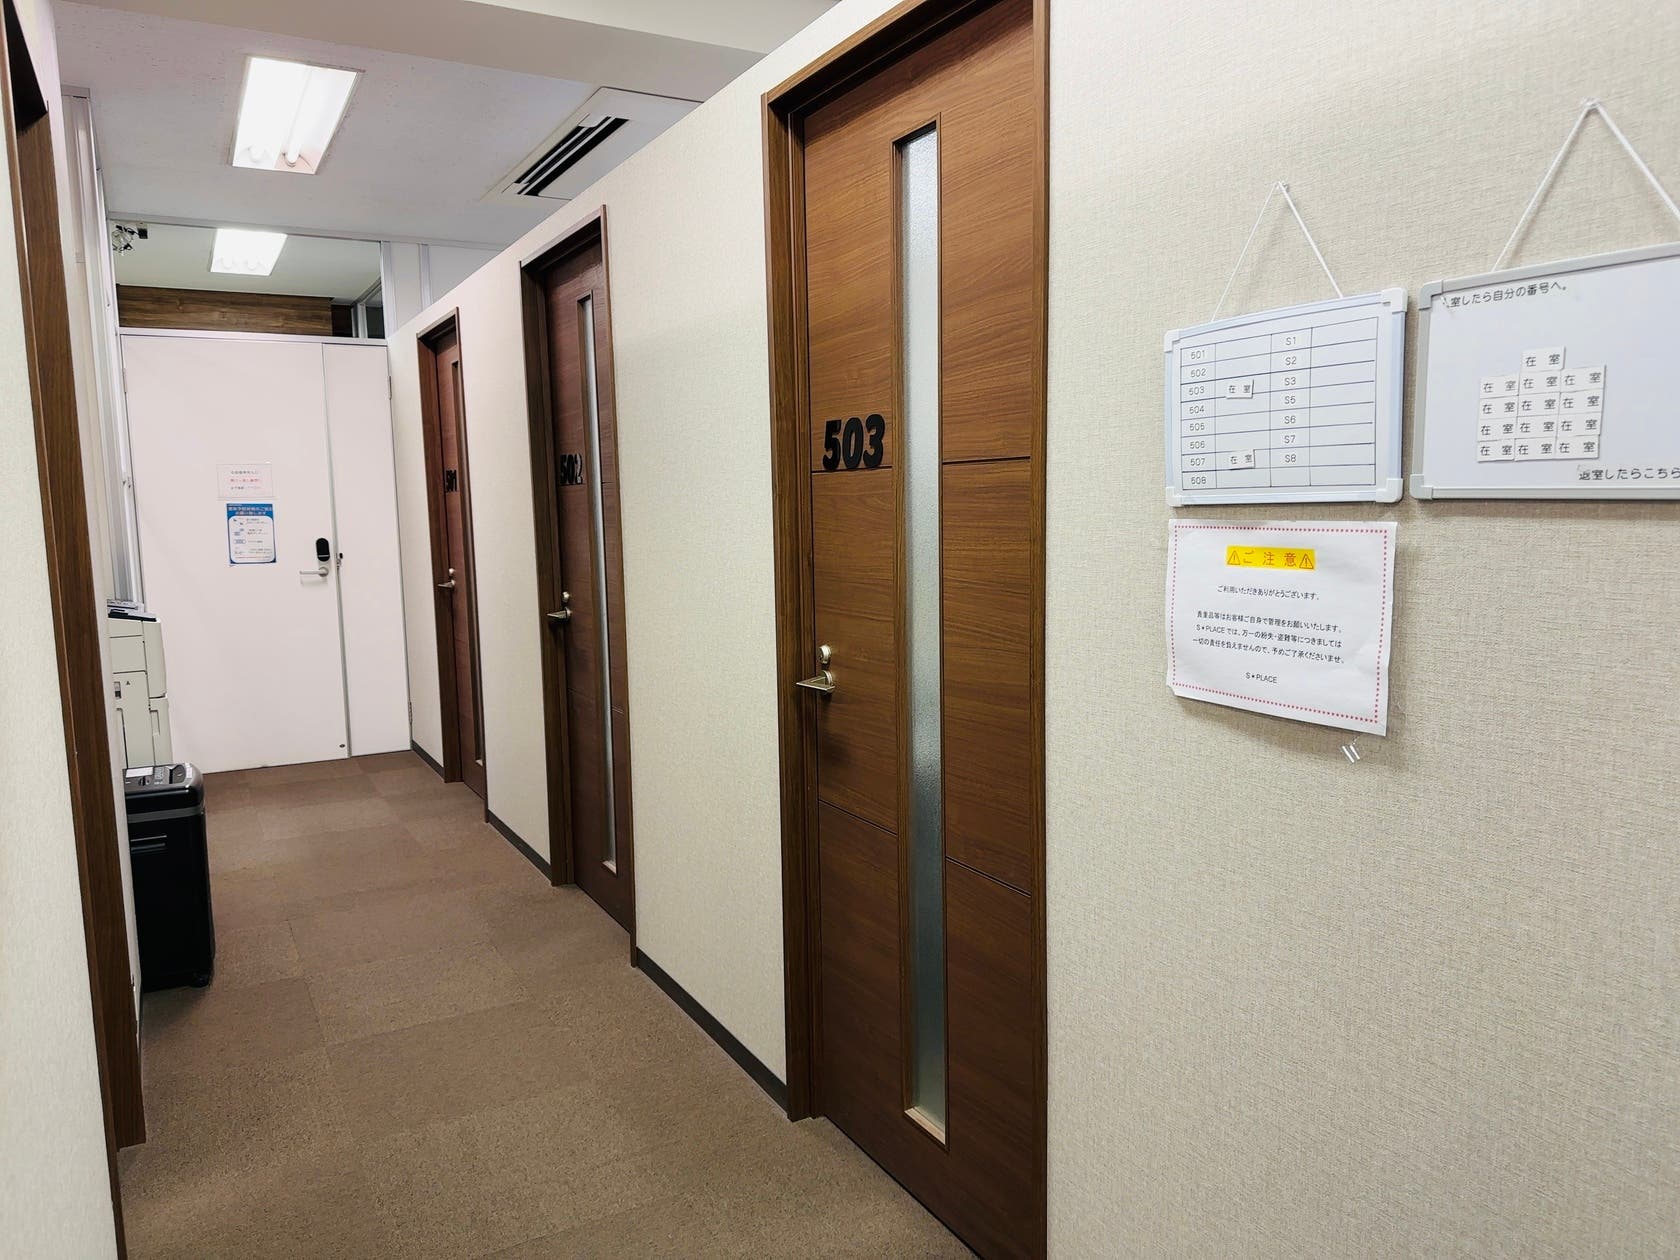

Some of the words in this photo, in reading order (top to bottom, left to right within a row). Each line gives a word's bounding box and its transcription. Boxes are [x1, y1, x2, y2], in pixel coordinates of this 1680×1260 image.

[1285, 337, 1296, 346] S1
[1190, 350, 1205, 360] 501
[1285, 356, 1297, 366] S2
[1525, 354, 1560, 367] 在室
[1190, 368, 1206, 378] 502
[1564, 372, 1601, 385] 在室
[1284, 376, 1296, 386] S3
[1483, 380, 1516, 393] 在室
[1523, 376, 1558, 389] 在室
[1188, 386, 1205, 396] 503
[1284, 395, 1296, 405] S5
[1521, 399, 1556, 411] 在室
[1563, 395, 1600, 409] 在室
[1189, 405, 1205, 414] 504
[1482, 401, 1515, 414] 在室
[1284, 415, 1296, 424] S6
[1561, 419, 1597, 431] 在室
[1189, 423, 1205, 431] 505
[1481, 423, 1514, 436] 在室
[1520, 421, 1555, 433] 在室
[823, 414, 885, 470] 503
[1284, 435, 1296, 444] S7
[1480, 444, 1512, 456] 在室
[1518, 443, 1552, 455] 在室
[1559, 441, 1595, 453] 在室
[1190, 457, 1205, 466] 507
[1285, 454, 1297, 463] S8
[560, 453, 583, 485] 502
[1190, 476, 1207, 485] 508
[1243, 550, 1297, 567] ご注意
[1217, 585, 1320, 601] ご利用いただきありがとうございます。
